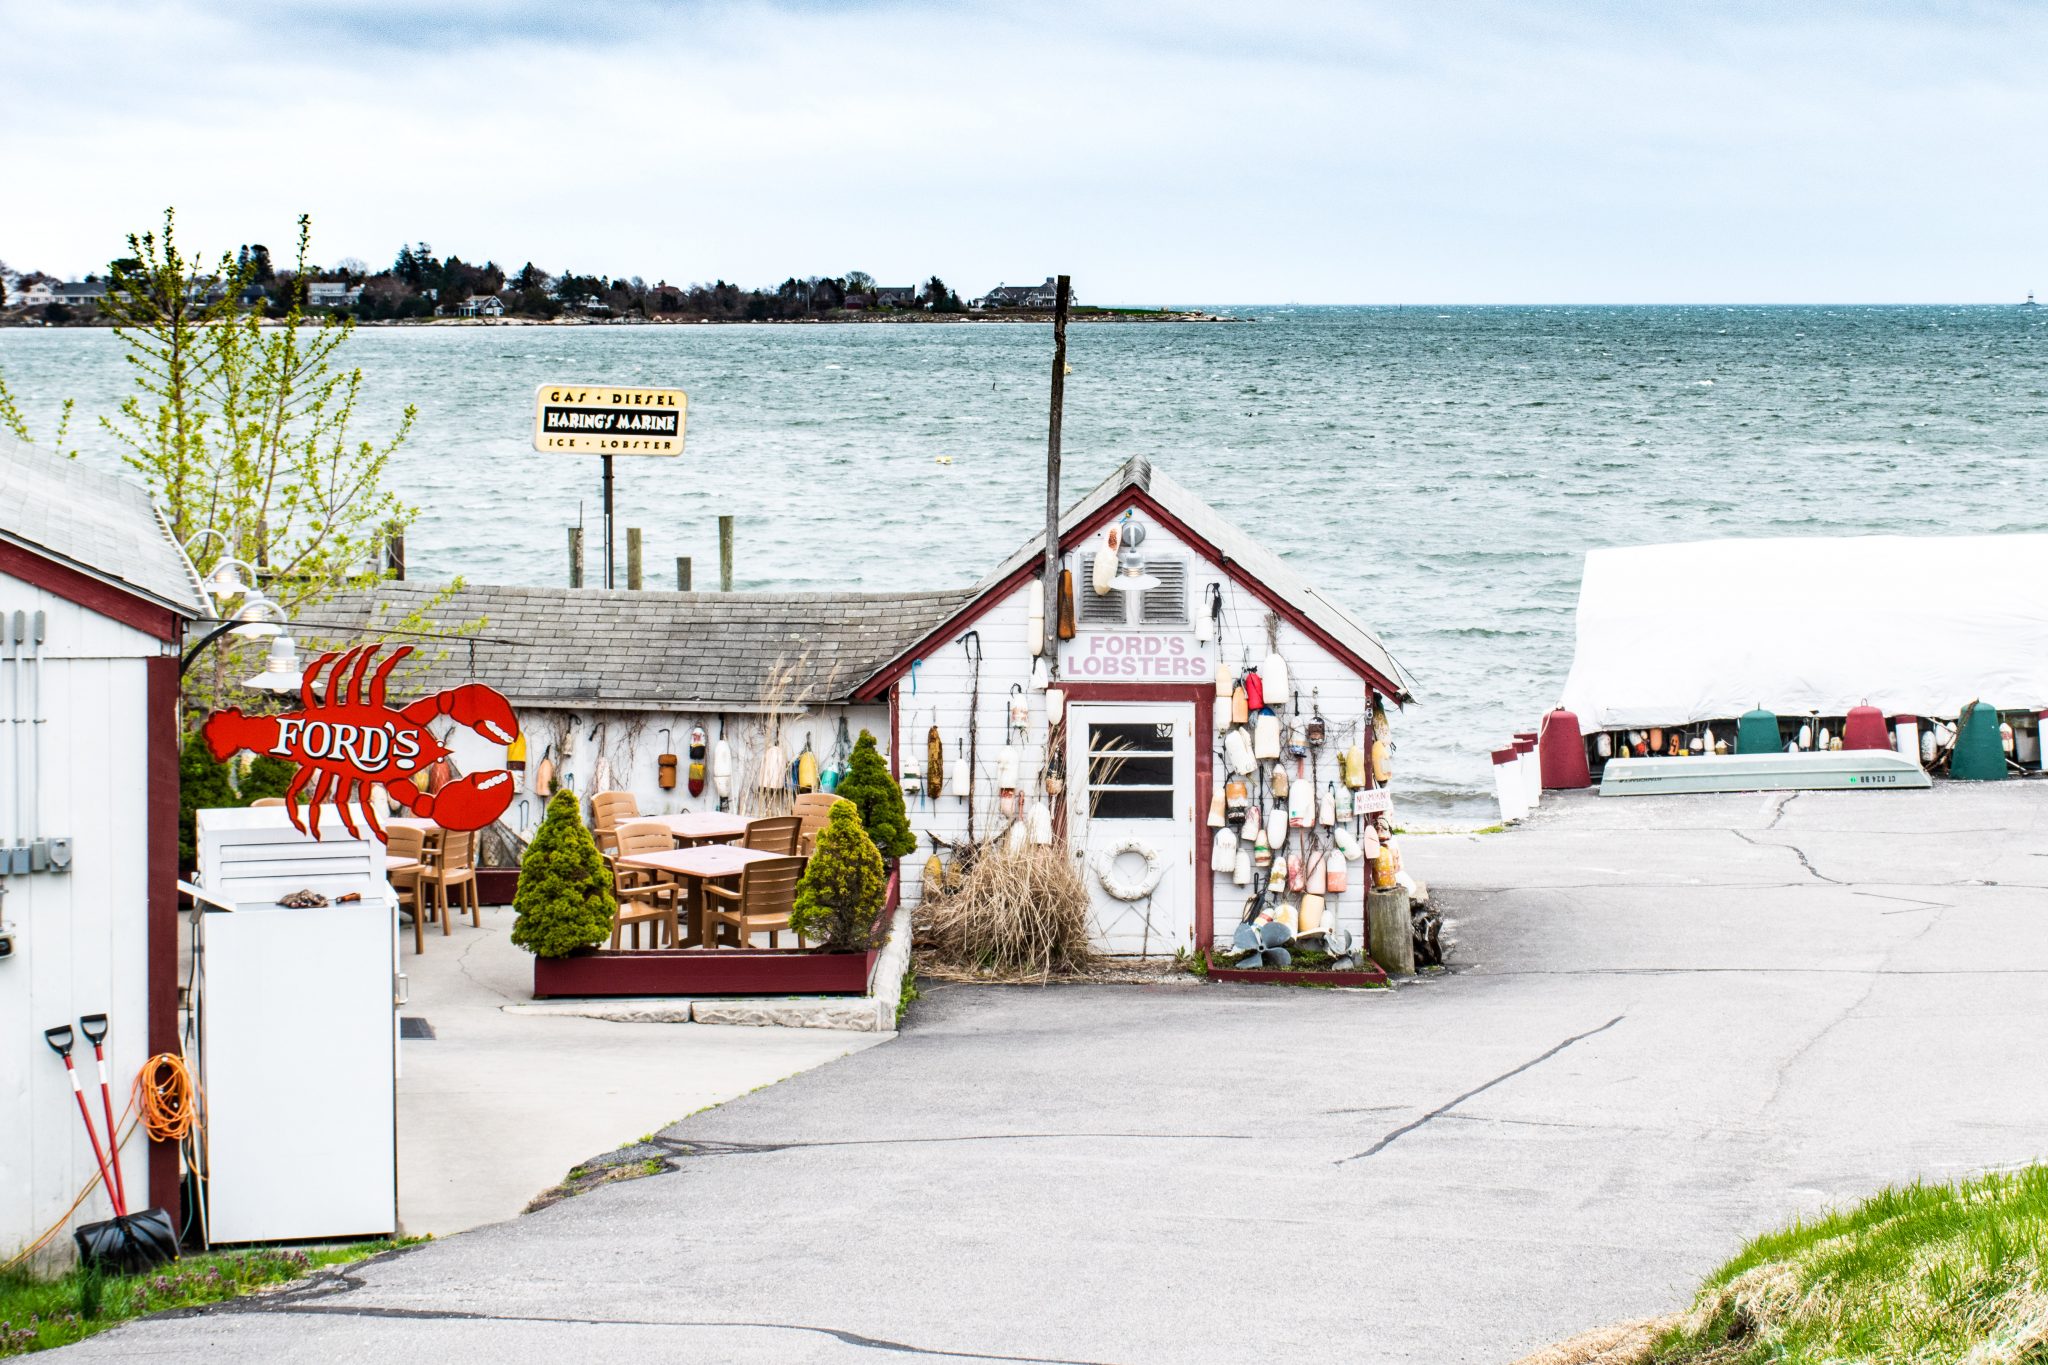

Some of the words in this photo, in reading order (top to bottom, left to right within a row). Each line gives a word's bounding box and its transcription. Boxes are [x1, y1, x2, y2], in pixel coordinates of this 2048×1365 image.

[551, 392, 586, 403] GAS
[612, 394, 675, 405] DIESEL
[547, 411, 614, 430] HARING'S
[616, 413, 676, 431] MARINE
[549, 438, 575, 447] ICE
[601, 440, 671, 449] LOBSTER
[1090, 636, 1185, 656] FORD'S
[1068, 656, 1206, 676] LOBSTERS
[269, 718, 420, 772] FORD'S
